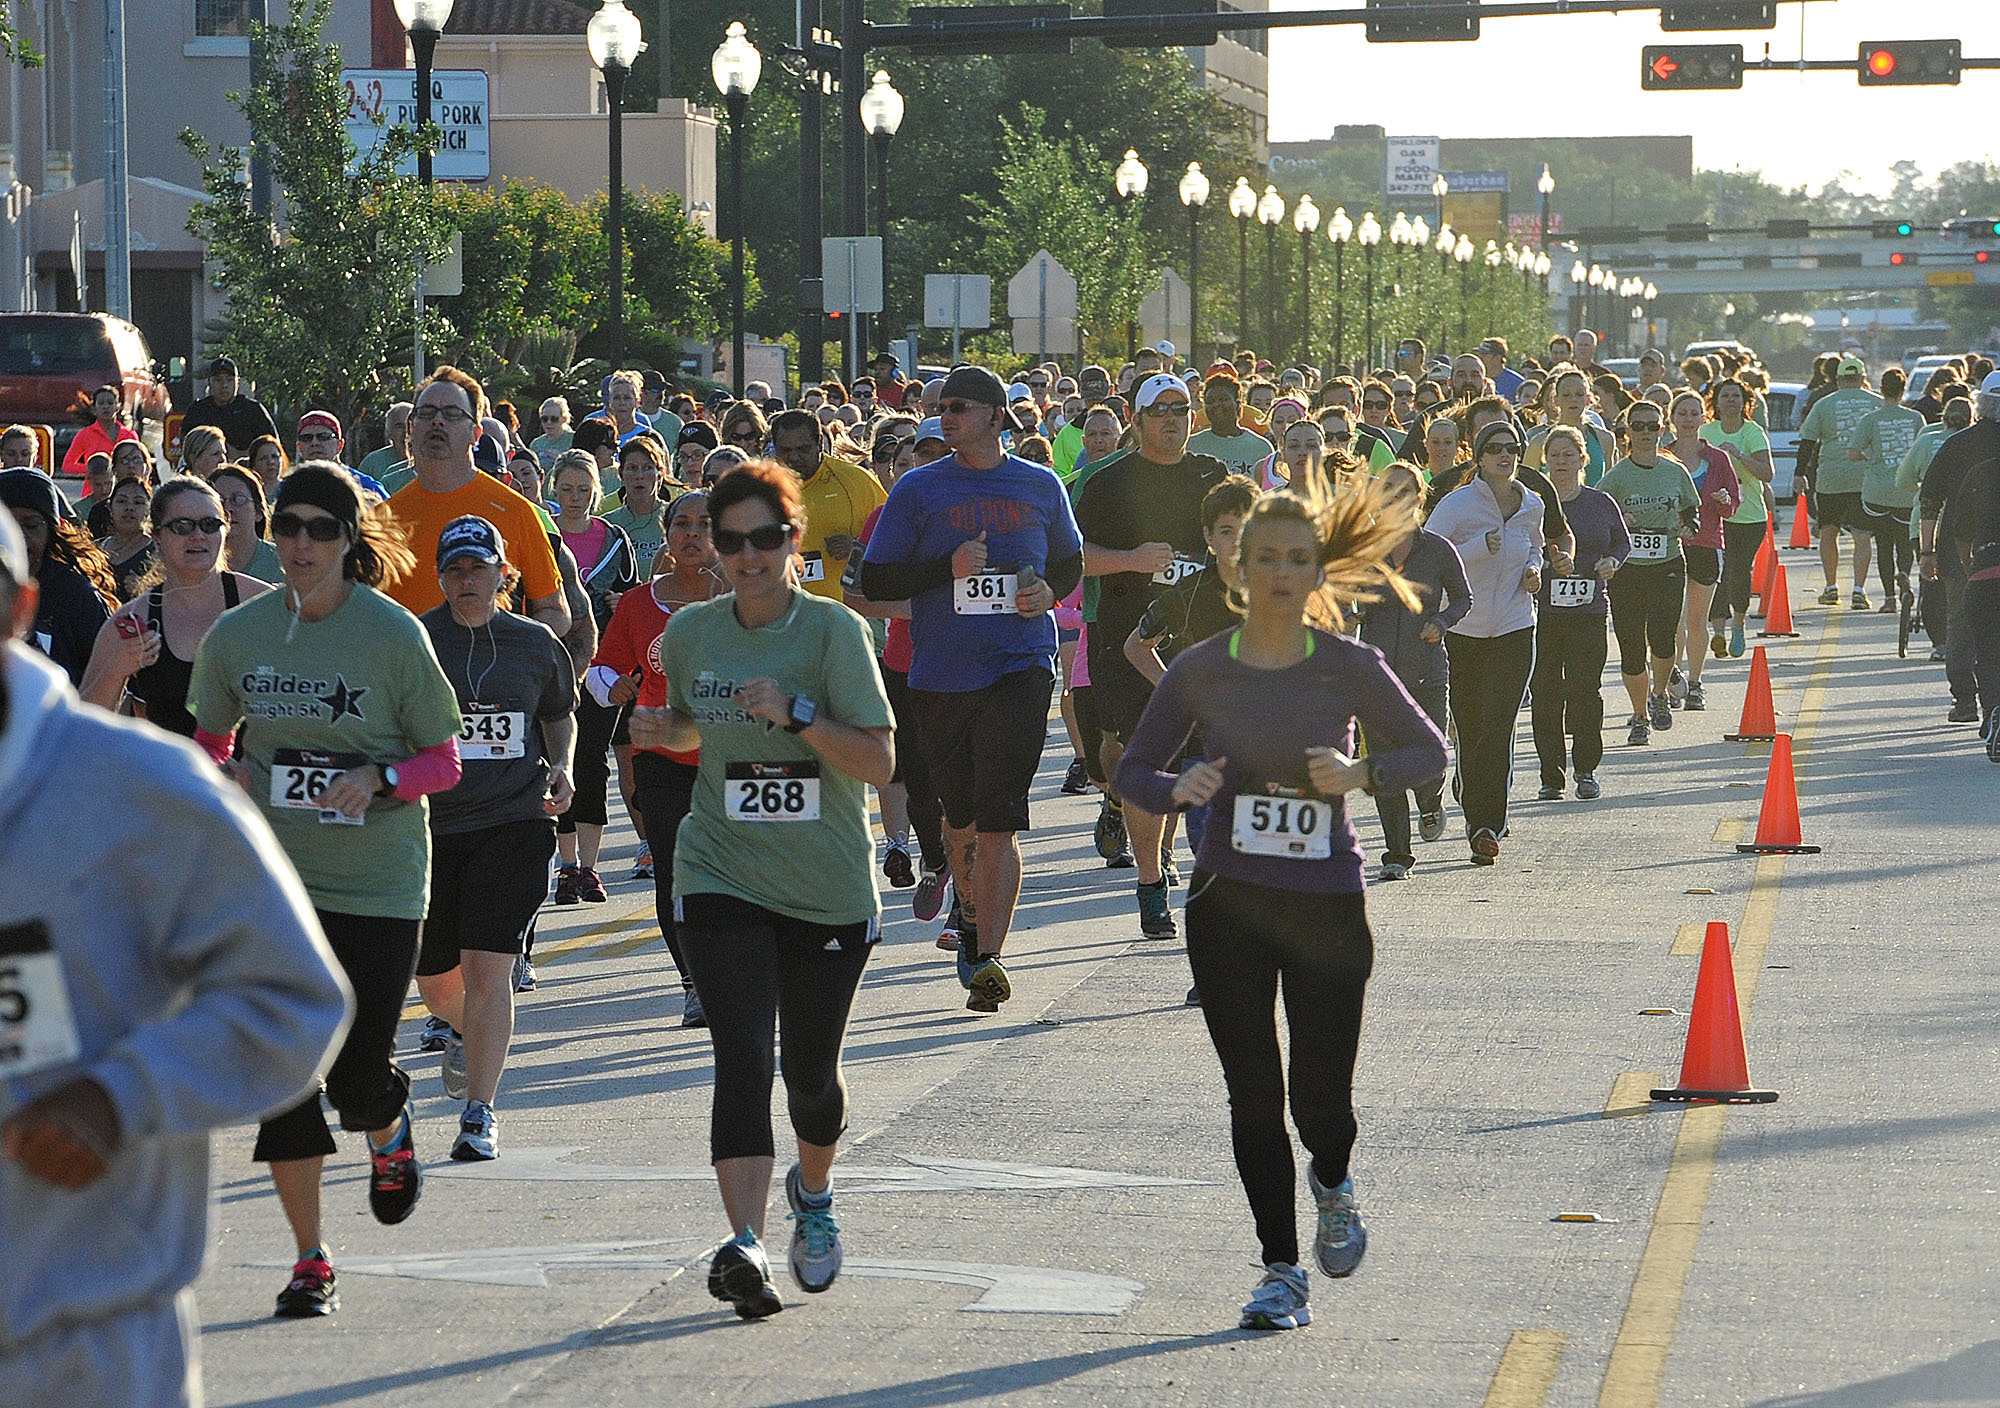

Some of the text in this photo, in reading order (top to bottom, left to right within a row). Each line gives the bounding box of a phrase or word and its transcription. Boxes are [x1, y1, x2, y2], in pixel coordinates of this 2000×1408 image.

[411, 81, 443, 99] BQ
[398, 105, 481, 124] PU PORK
[1400, 149, 1426, 158] GAS
[1395, 165, 1430, 173] FOOD
[1395, 173, 1430, 181] MART
[1445, 174, 1507, 187] uburban
[1624, 496, 1665, 507] Calder
[1633, 535, 1661, 549] 538
[966, 577, 1006, 599] 361
[1558, 581, 1589, 596] 713
[242, 673, 328, 695] Calder
[691, 679, 746, 698] Calde
[299, 702, 321, 718] 5K
[735, 709, 757, 723] 5K
[458, 715, 512, 740] 643
[739, 781, 805, 814] 268
[1251, 799, 1318, 835] 510
